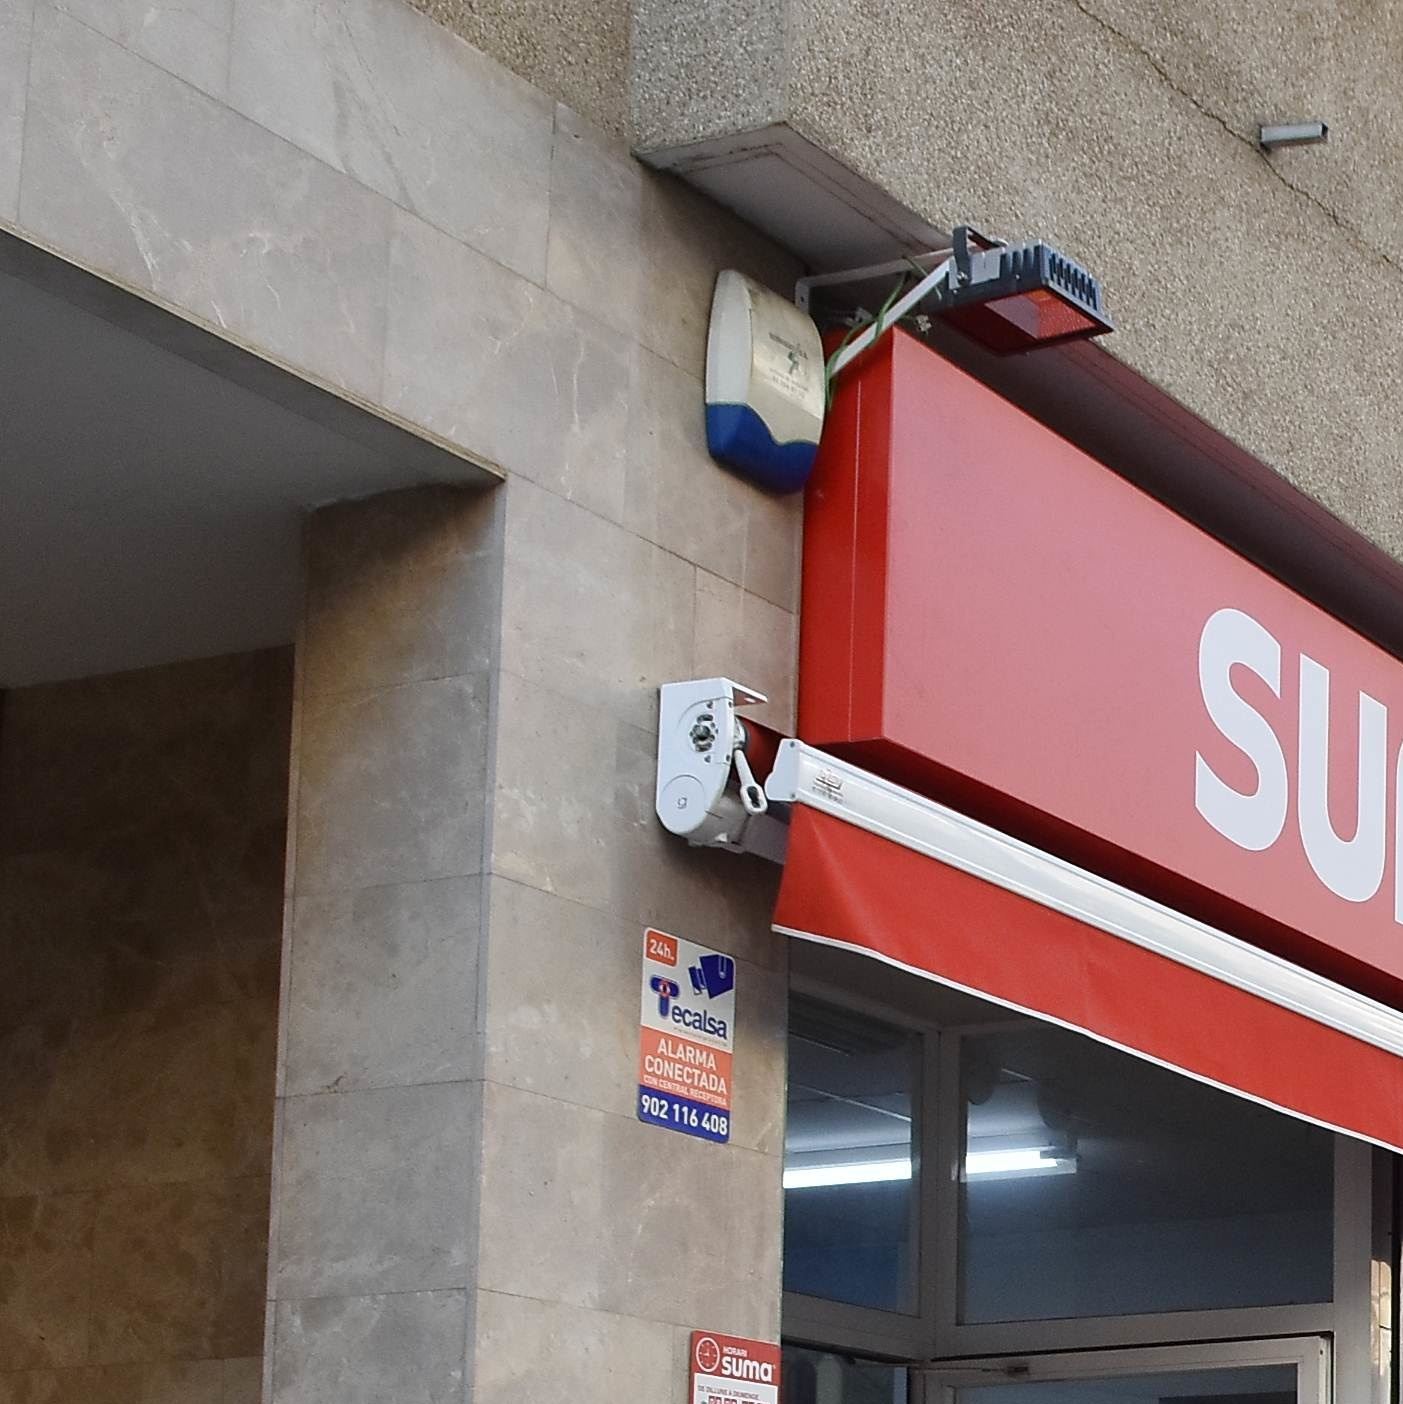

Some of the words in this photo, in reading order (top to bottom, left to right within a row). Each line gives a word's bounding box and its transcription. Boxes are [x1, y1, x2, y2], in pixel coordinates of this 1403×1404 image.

[650, 974, 728, 1040] Tecalsa
[657, 1038, 716, 1071] ALARMA
[645, 1055, 727, 1094] CONECTADA
[641, 1095, 668, 1119] 902
[673, 1104, 698, 1127] 116
[701, 1112, 728, 1135] 408
[722, 1356, 772, 1382] suma
